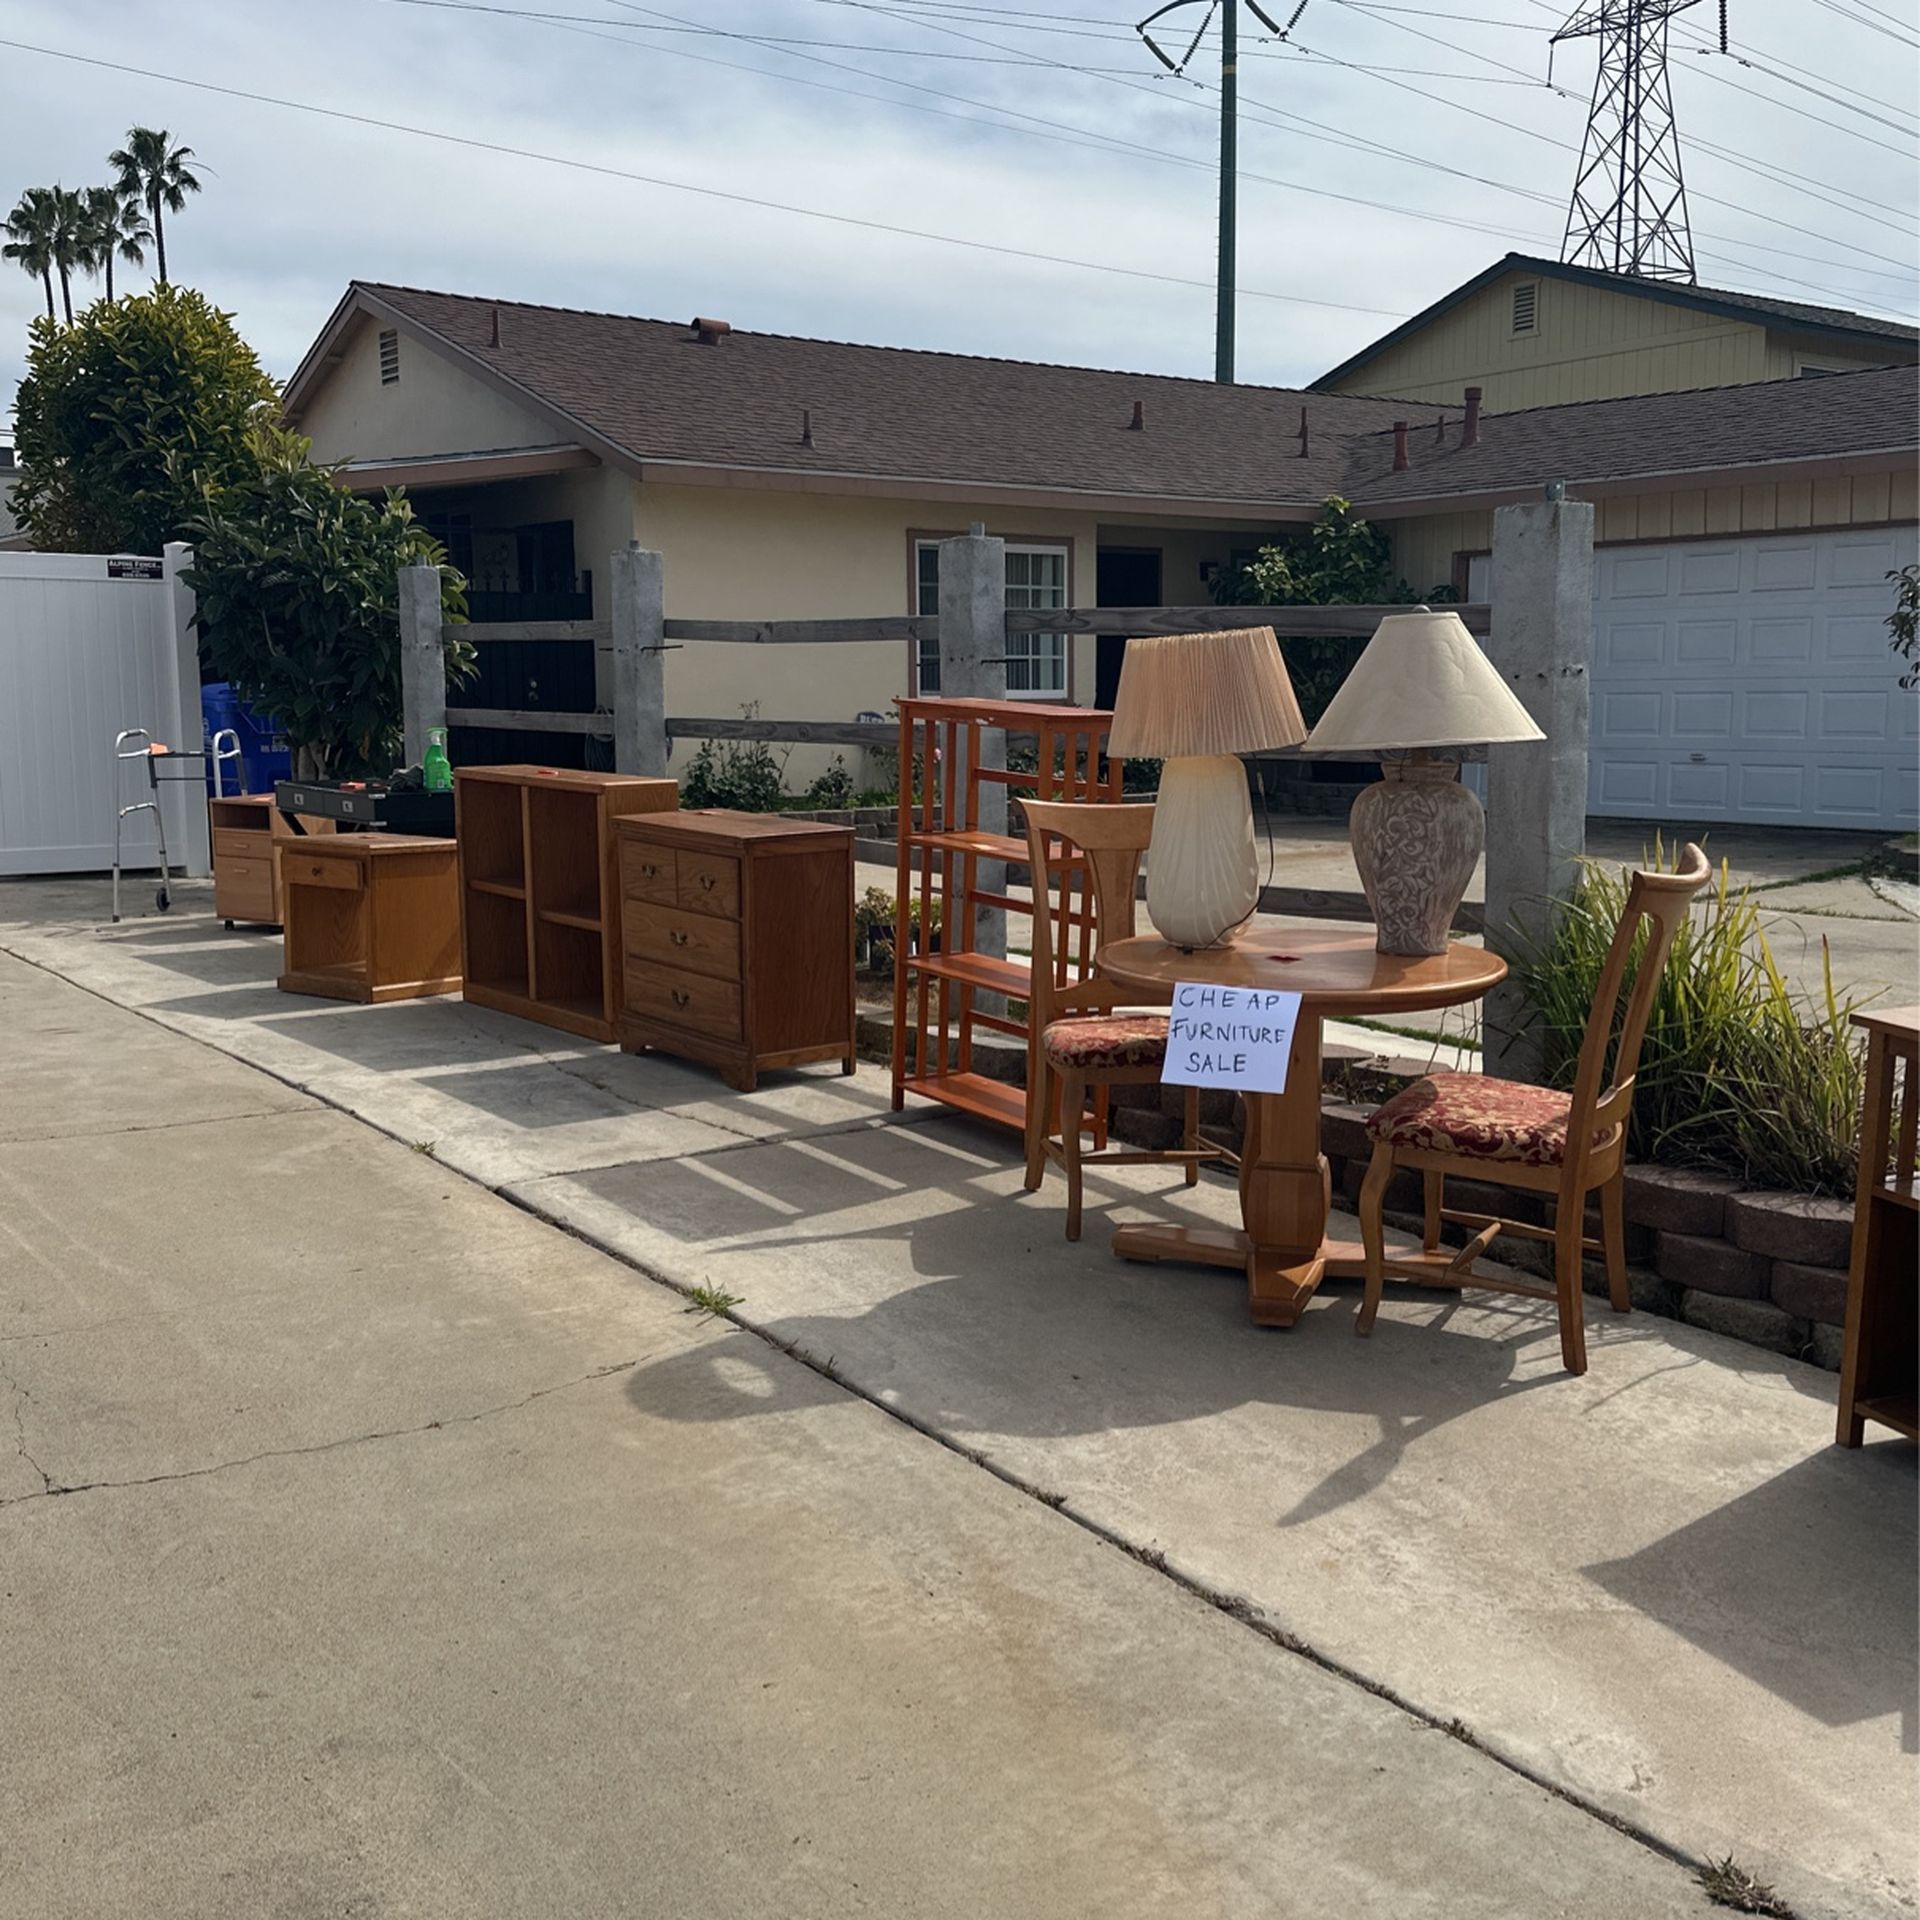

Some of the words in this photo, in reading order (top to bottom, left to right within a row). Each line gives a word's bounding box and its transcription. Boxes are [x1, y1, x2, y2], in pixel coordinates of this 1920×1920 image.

[1179, 987, 1280, 1010] CHEAP
[1171, 1018, 1286, 1044] FURNITURE
[1184, 1052, 1247, 1073] SALE
